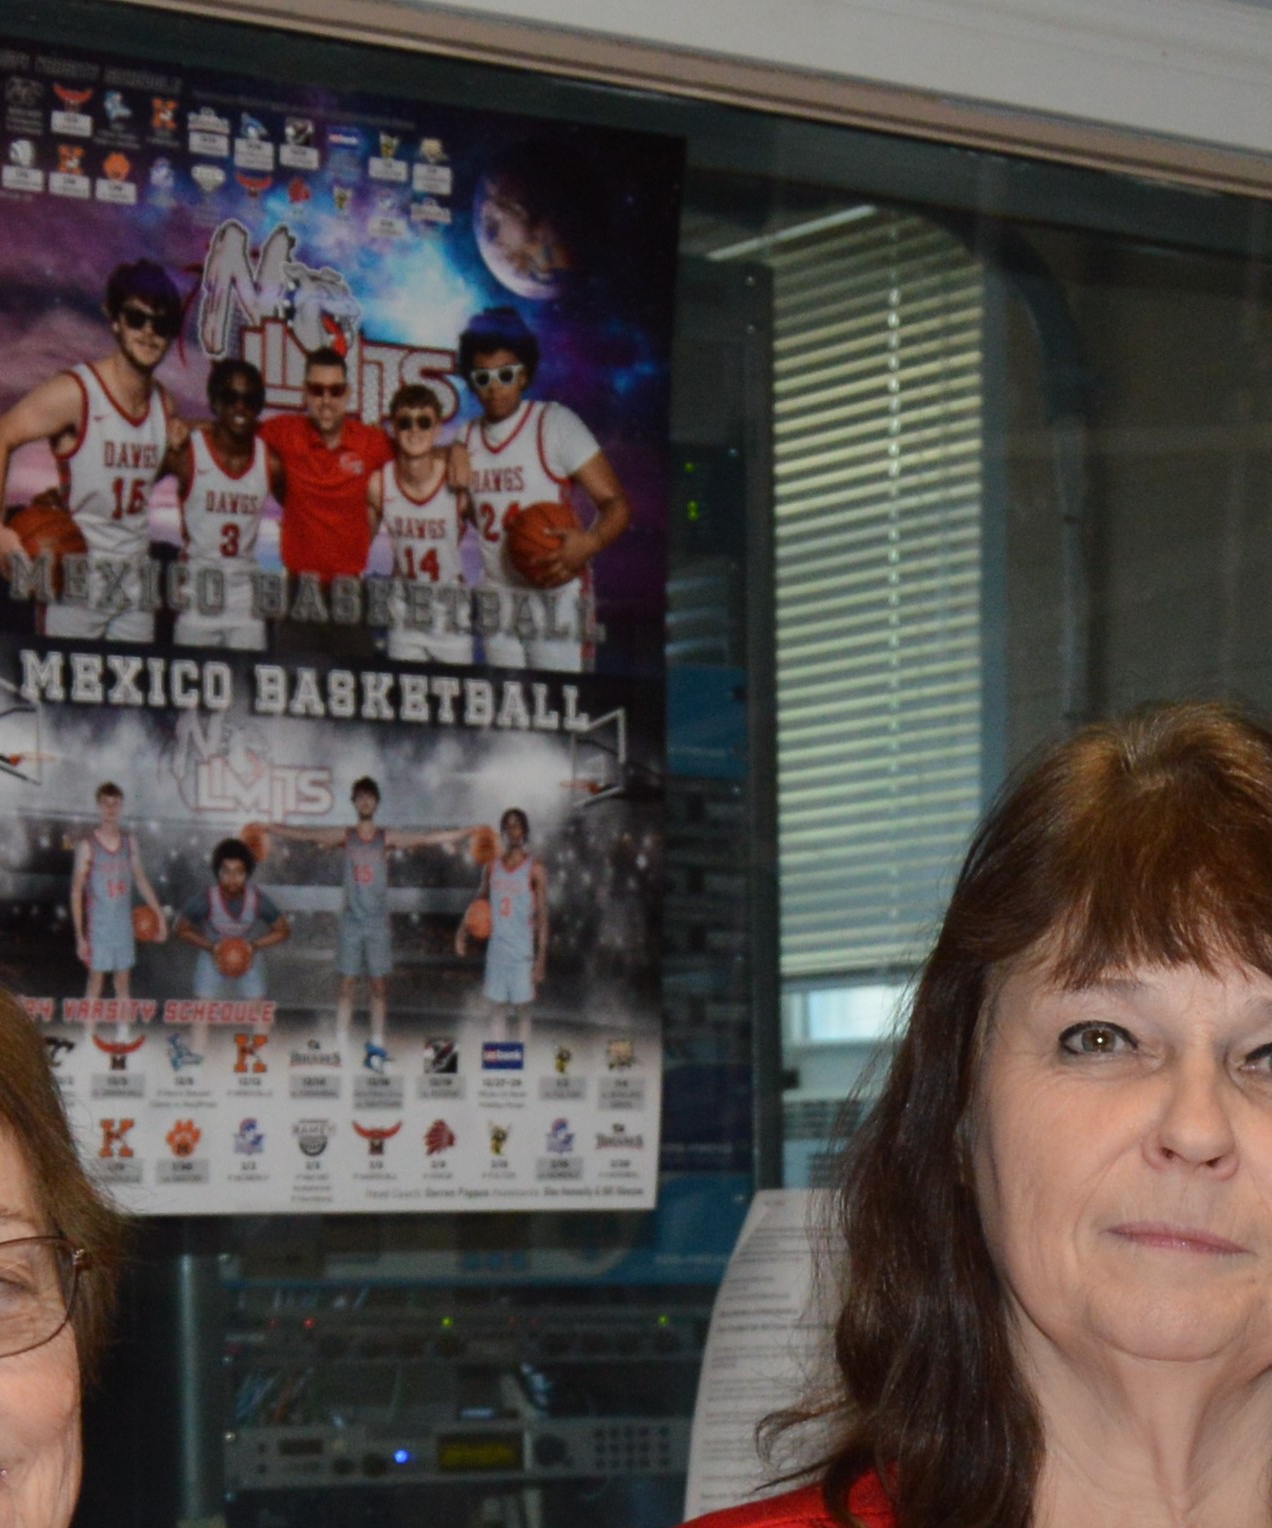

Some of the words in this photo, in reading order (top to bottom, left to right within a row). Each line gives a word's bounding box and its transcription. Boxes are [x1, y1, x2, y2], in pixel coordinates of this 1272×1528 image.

[219, 523, 240, 558] 3
[404, 547, 440, 582] 14
[9, 552, 227, 617] MEXICO
[251, 571, 606, 643] BASKETBALL
[20, 650, 232, 709] MEXICO
[254, 664, 592, 732] BASKETBALL
[63, 998, 157, 1023] VARSITY
[164, 999, 277, 1025] SCHEDULE
